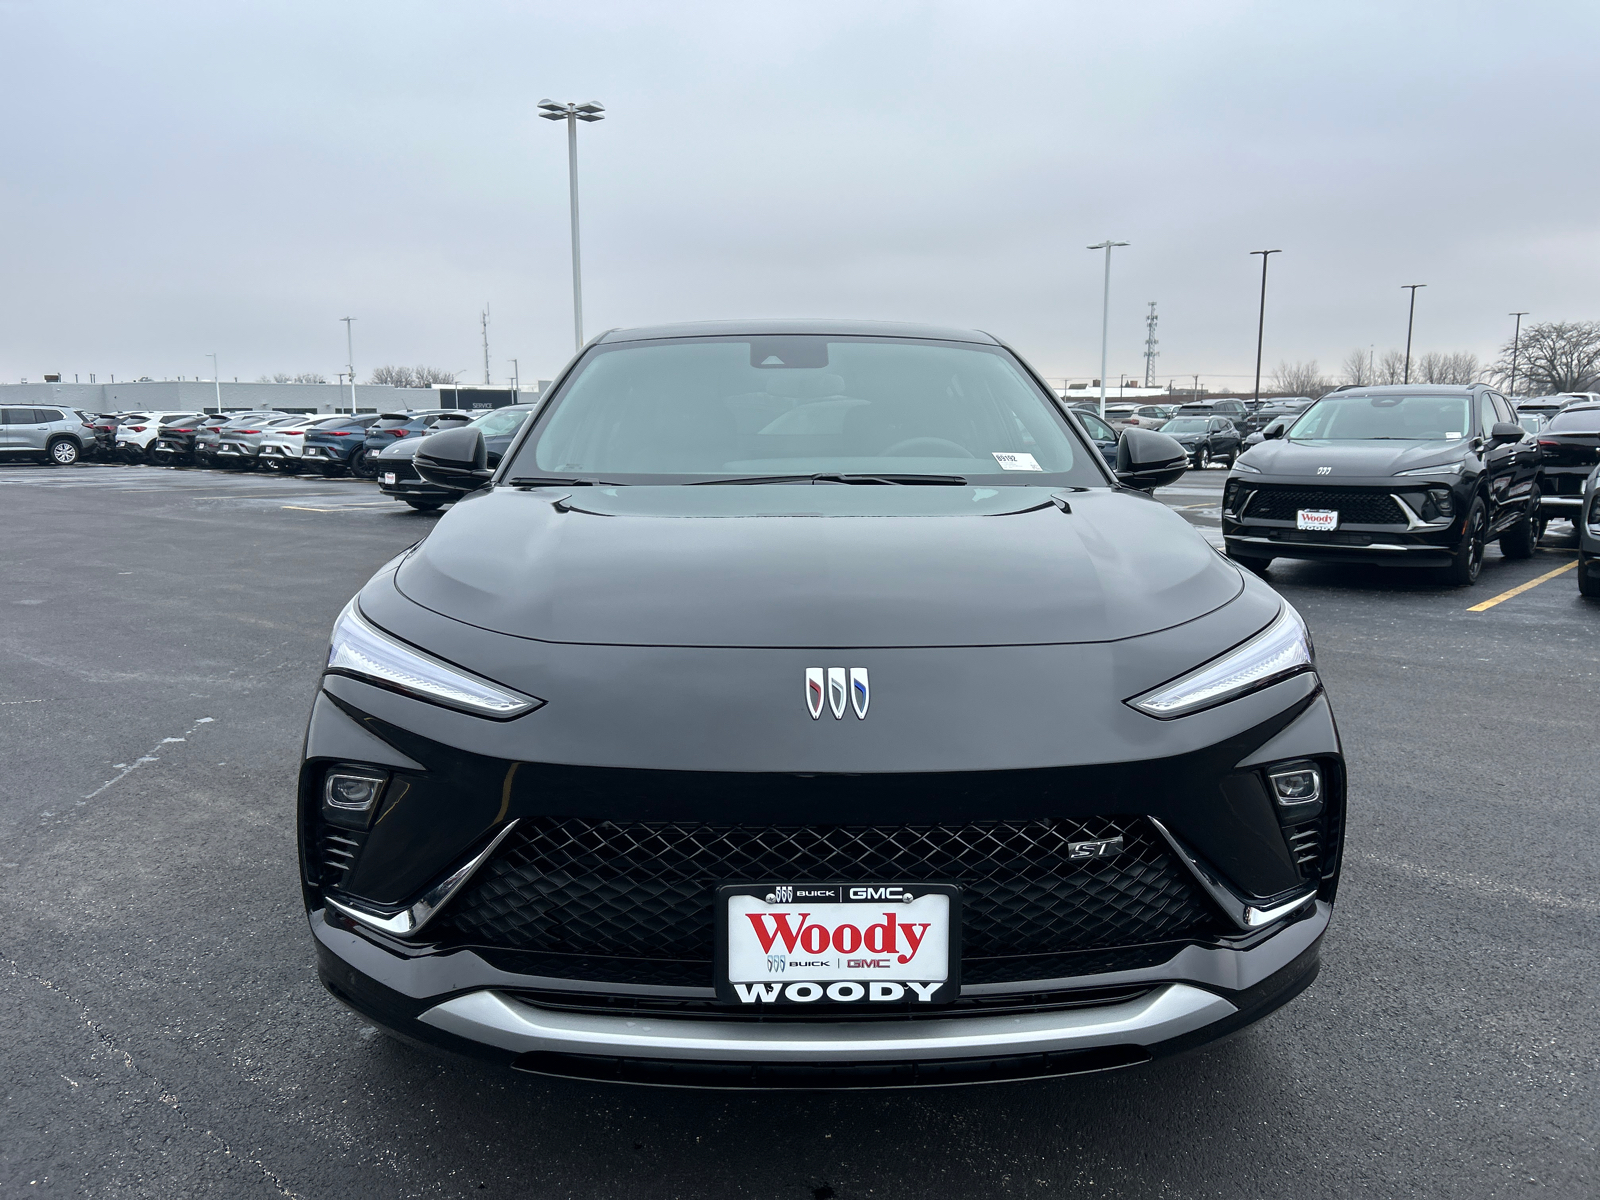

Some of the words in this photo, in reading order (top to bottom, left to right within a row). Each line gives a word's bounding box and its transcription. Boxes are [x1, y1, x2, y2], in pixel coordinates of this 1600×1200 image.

[1301, 513, 1334, 524] Woody
[1070, 838, 1120, 859] ST
[796, 890, 835, 898] BUICK
[849, 887, 904, 900] GMC
[745, 912, 931, 965] Woody
[847, 959, 891, 969] GMC
[733, 982, 944, 1003] WOODY
